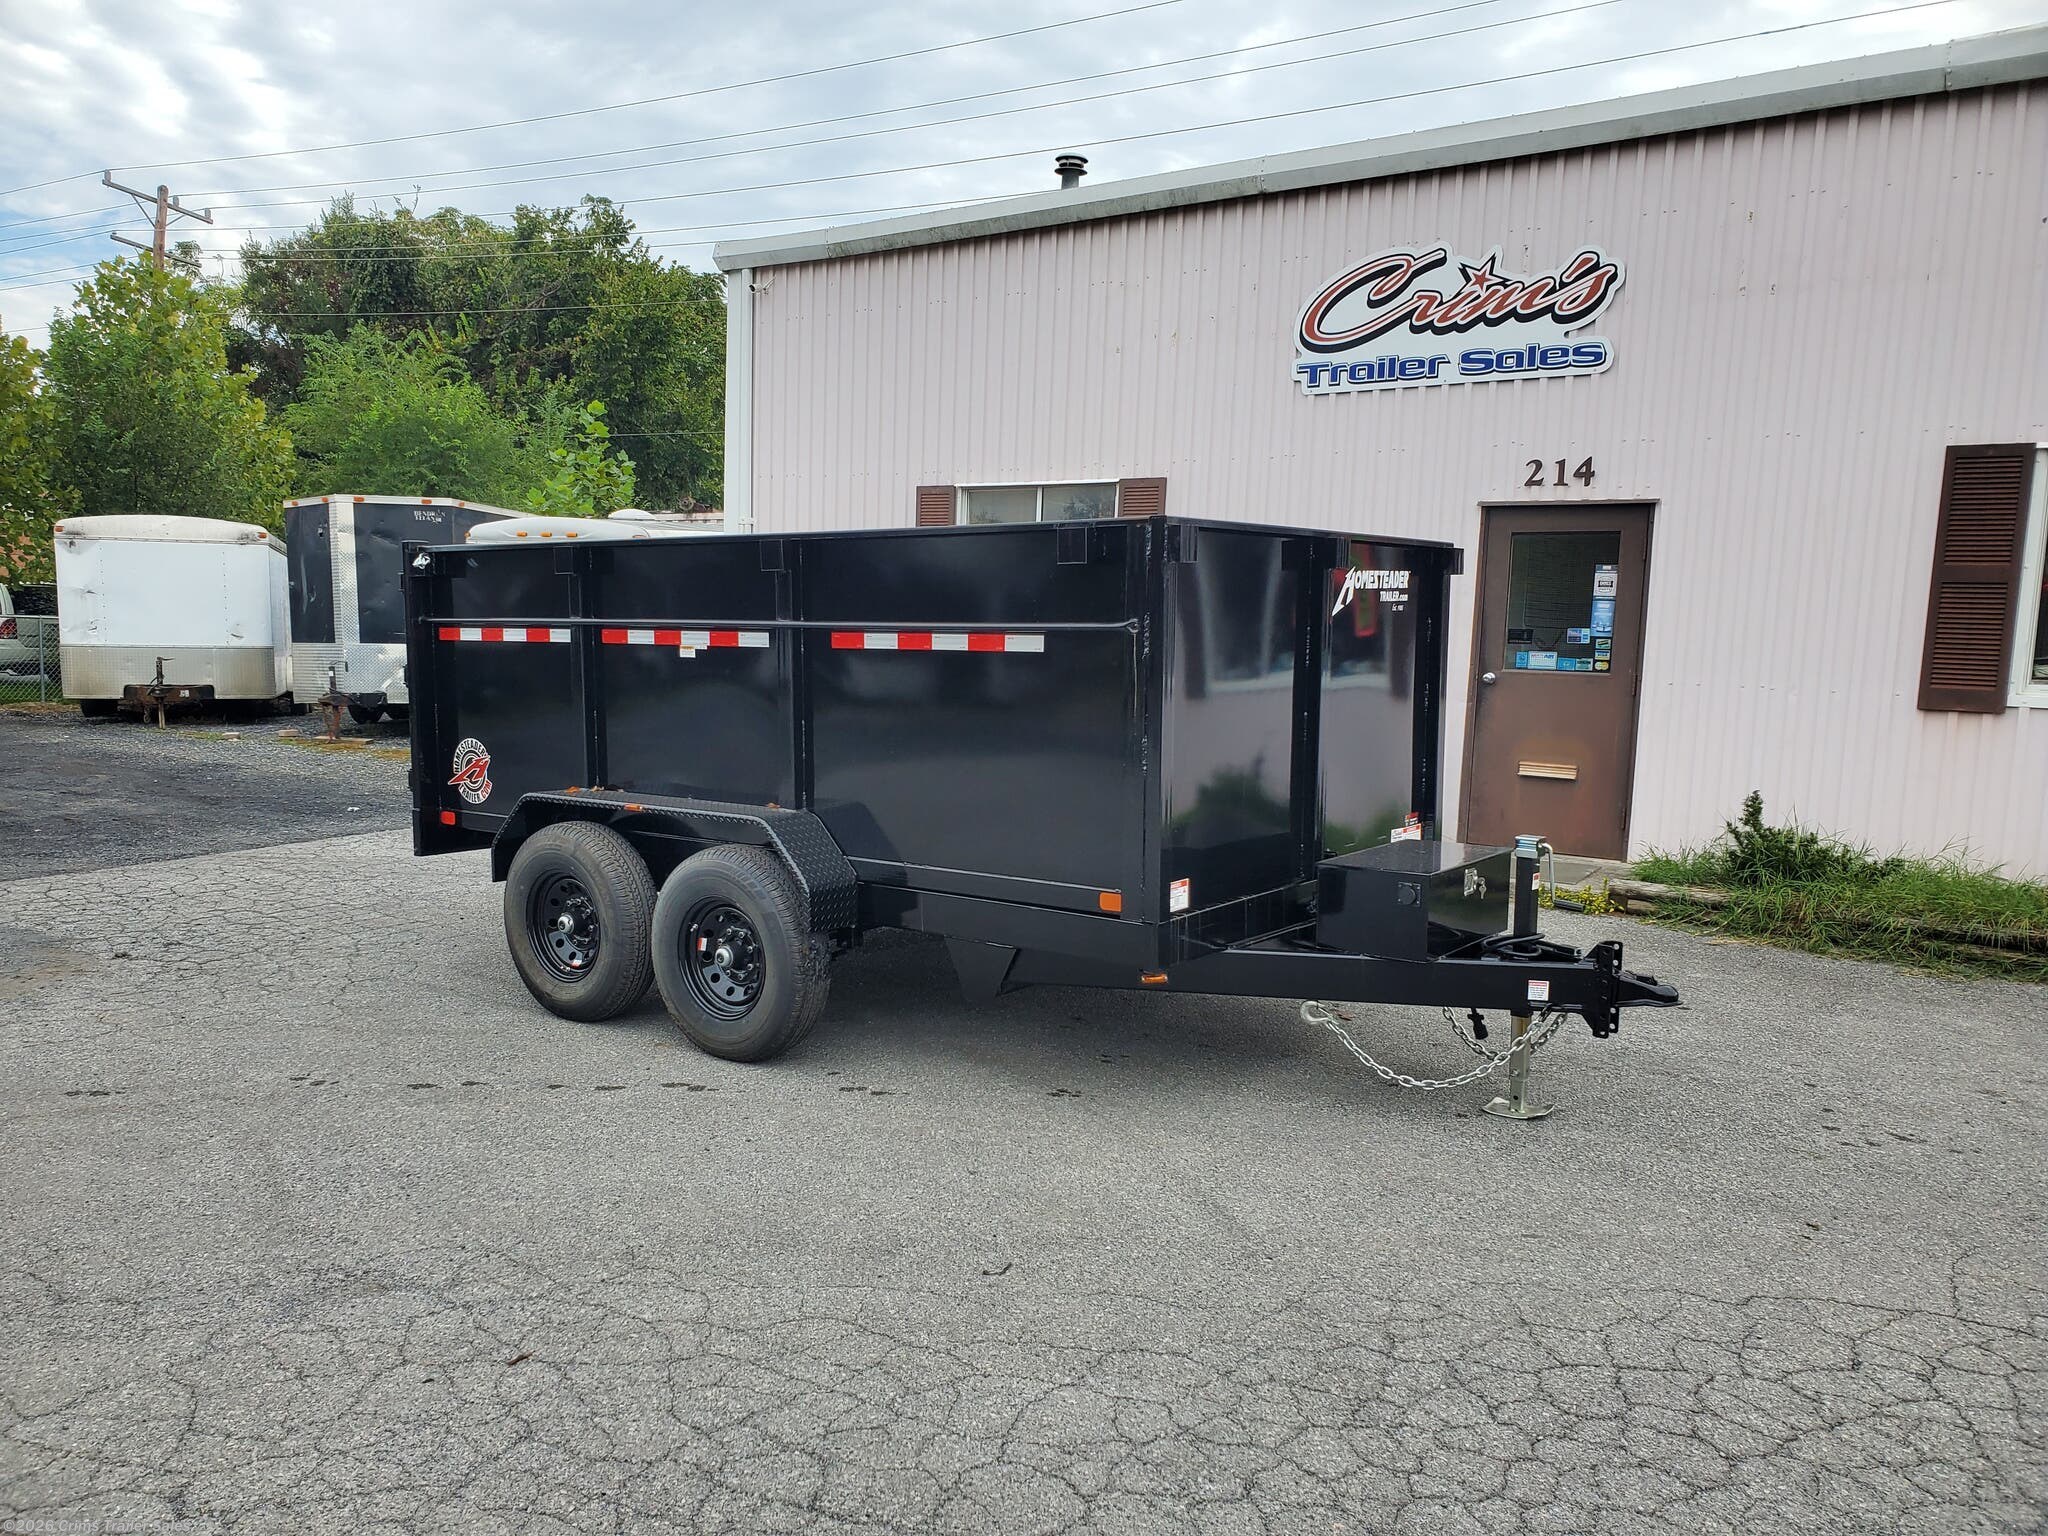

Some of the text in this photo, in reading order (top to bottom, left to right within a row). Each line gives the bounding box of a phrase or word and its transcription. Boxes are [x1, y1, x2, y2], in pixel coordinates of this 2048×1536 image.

[1300, 248, 1618, 353] Crim's
[1297, 341, 1608, 388] Trailer Sales
[1524, 456, 1595, 487] 214
[1332, 566, 1409, 616] HOMESTEADER
[454, 739, 487, 773] HOMESTEADER
